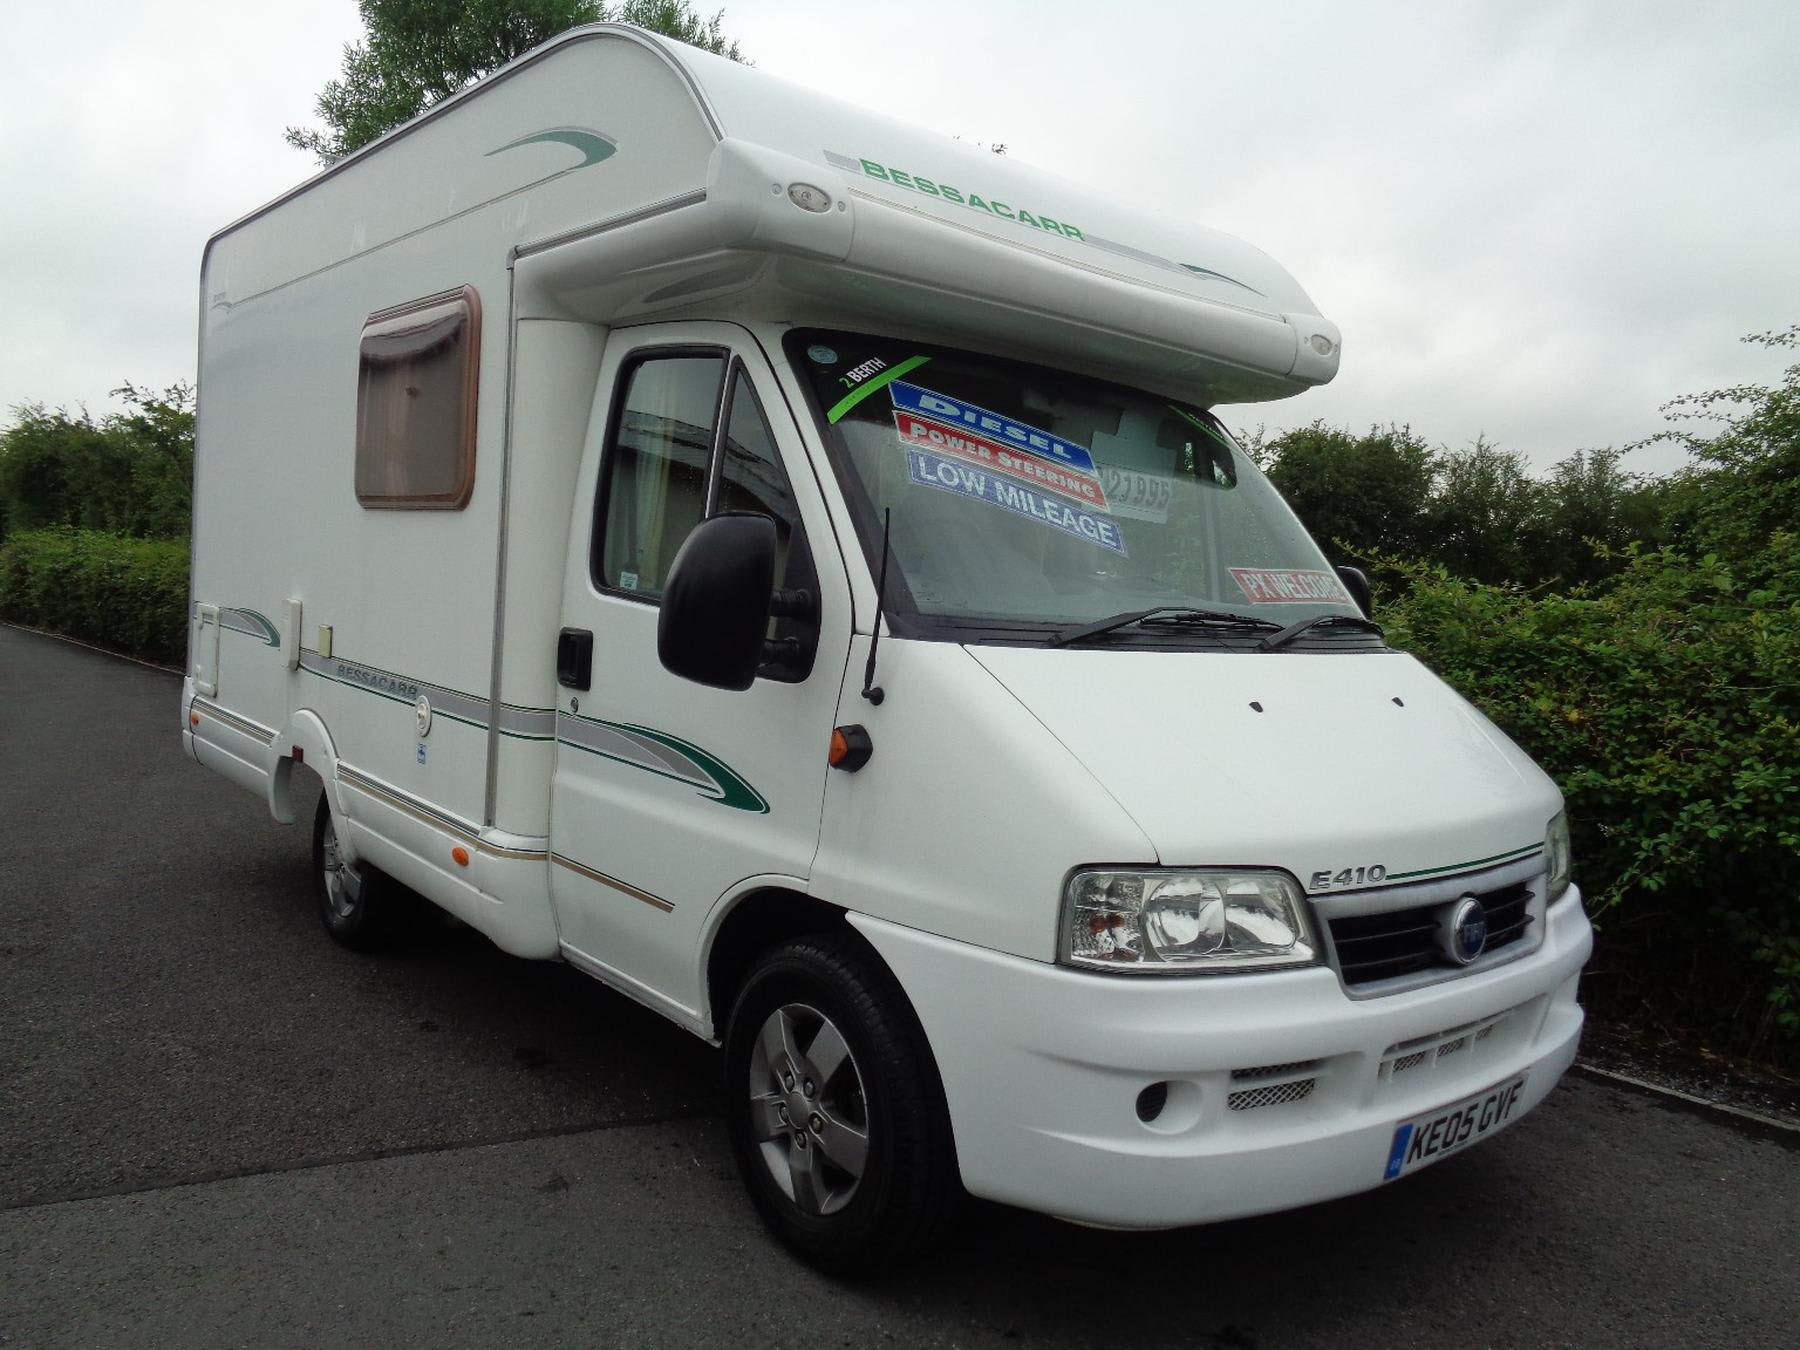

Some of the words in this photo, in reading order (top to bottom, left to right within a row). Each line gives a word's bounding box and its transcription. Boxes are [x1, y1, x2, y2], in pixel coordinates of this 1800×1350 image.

[859, 158, 1086, 241] BESSACARR
[838, 377, 855, 389] 2
[846, 356, 888, 383] BERTH
[919, 394, 1072, 459] DIESEL
[919, 456, 986, 497] LOW
[996, 481, 1118, 547] MILEAGE
[337, 664, 418, 700] BESSACARR
[1309, 864, 1386, 890] E410
[1407, 1103, 1479, 1164] KE05
[1478, 1080, 1524, 1132] GVF
